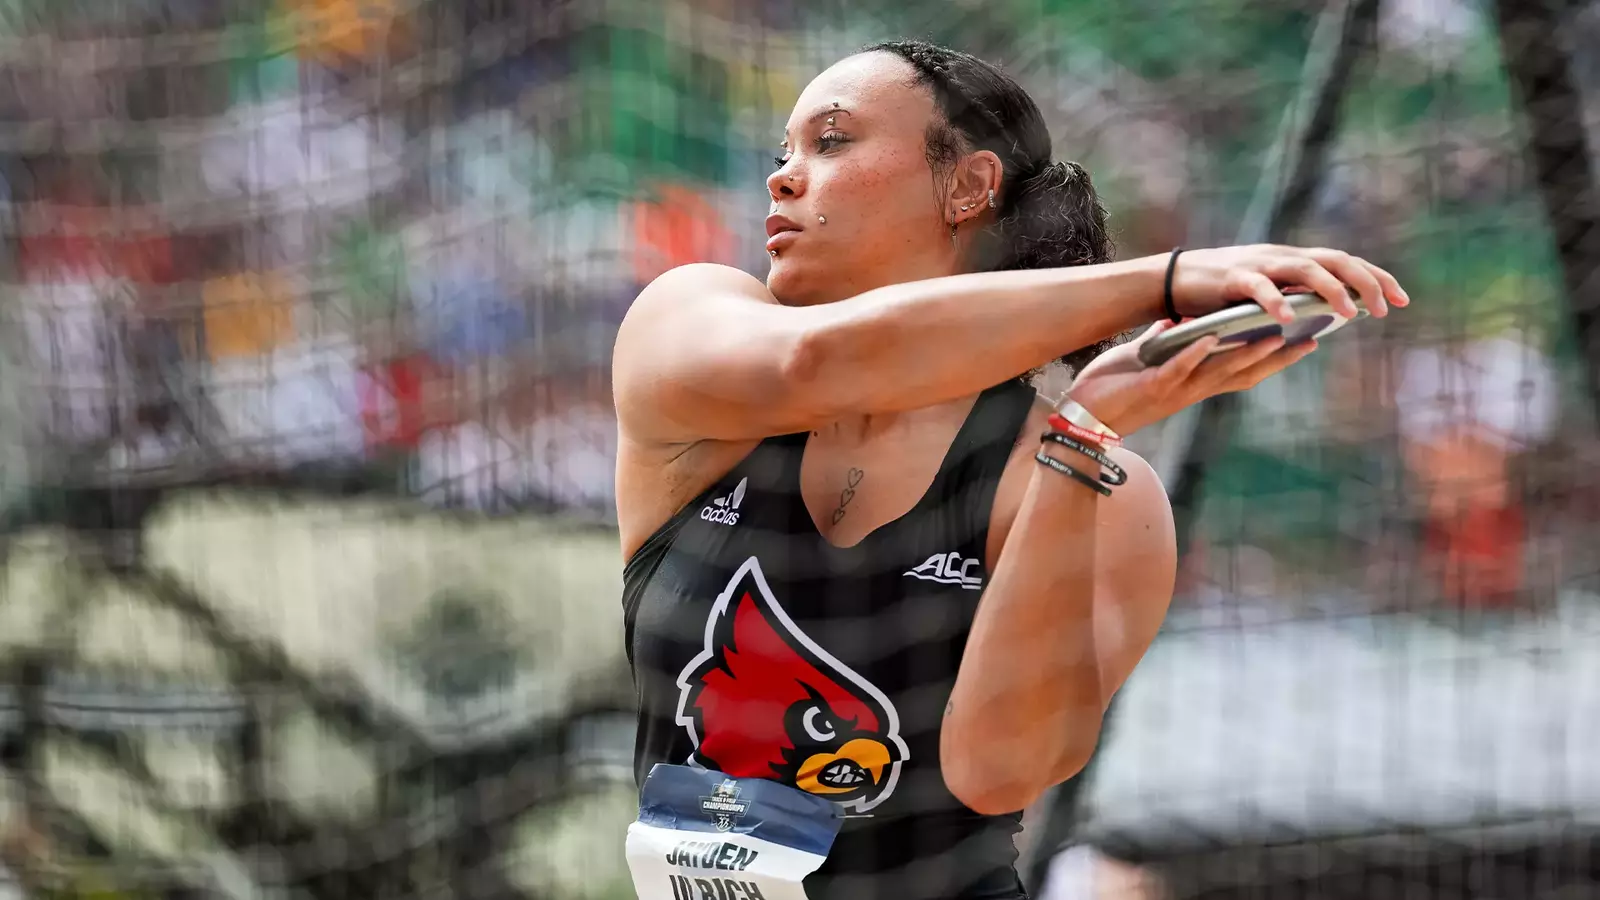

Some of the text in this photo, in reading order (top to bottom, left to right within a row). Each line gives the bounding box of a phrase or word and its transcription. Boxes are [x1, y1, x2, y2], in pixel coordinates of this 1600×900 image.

[911, 551, 982, 584] ACC
[702, 801, 746, 813] CHAMPIONSHIPS
[666, 841, 759, 871] JAYDEN
